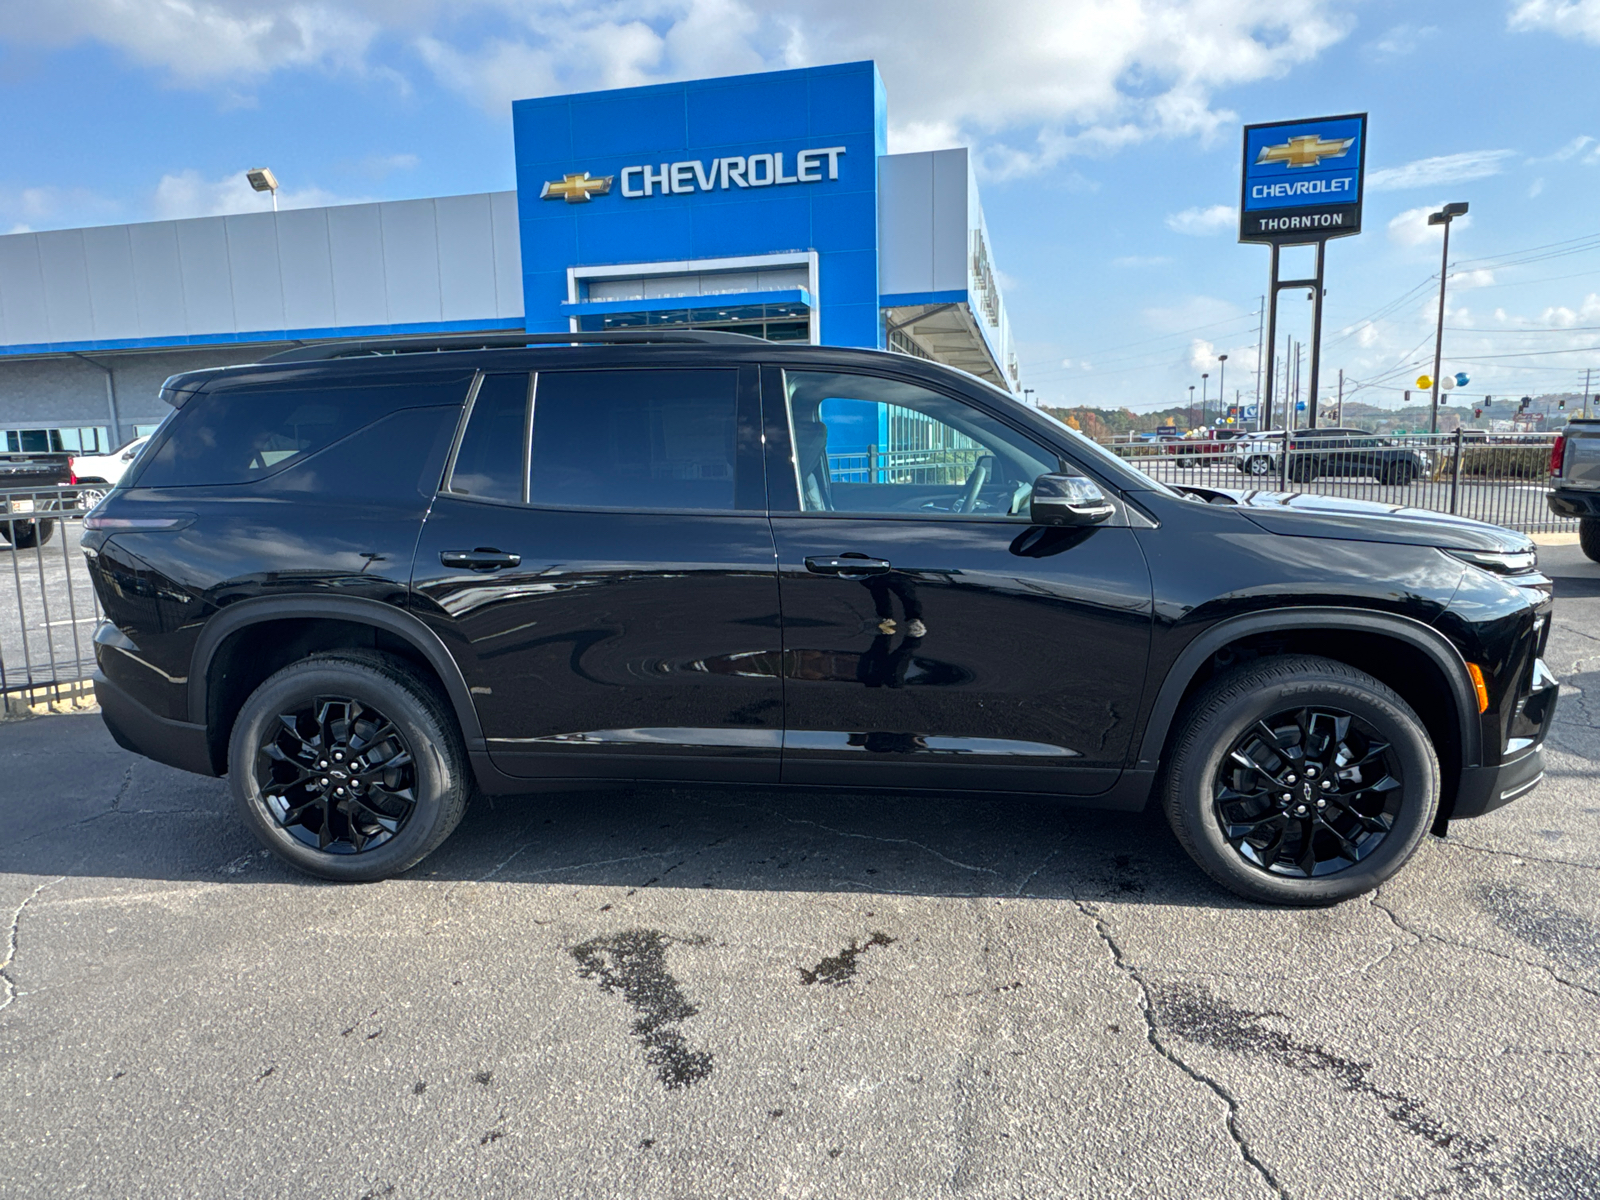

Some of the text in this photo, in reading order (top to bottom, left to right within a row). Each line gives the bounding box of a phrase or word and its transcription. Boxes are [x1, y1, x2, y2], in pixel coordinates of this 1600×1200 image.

[620, 146, 846, 198] CHEVROLET
[1252, 177, 1353, 199] CHEVROLET
[1260, 213, 1343, 231] THORNTON
